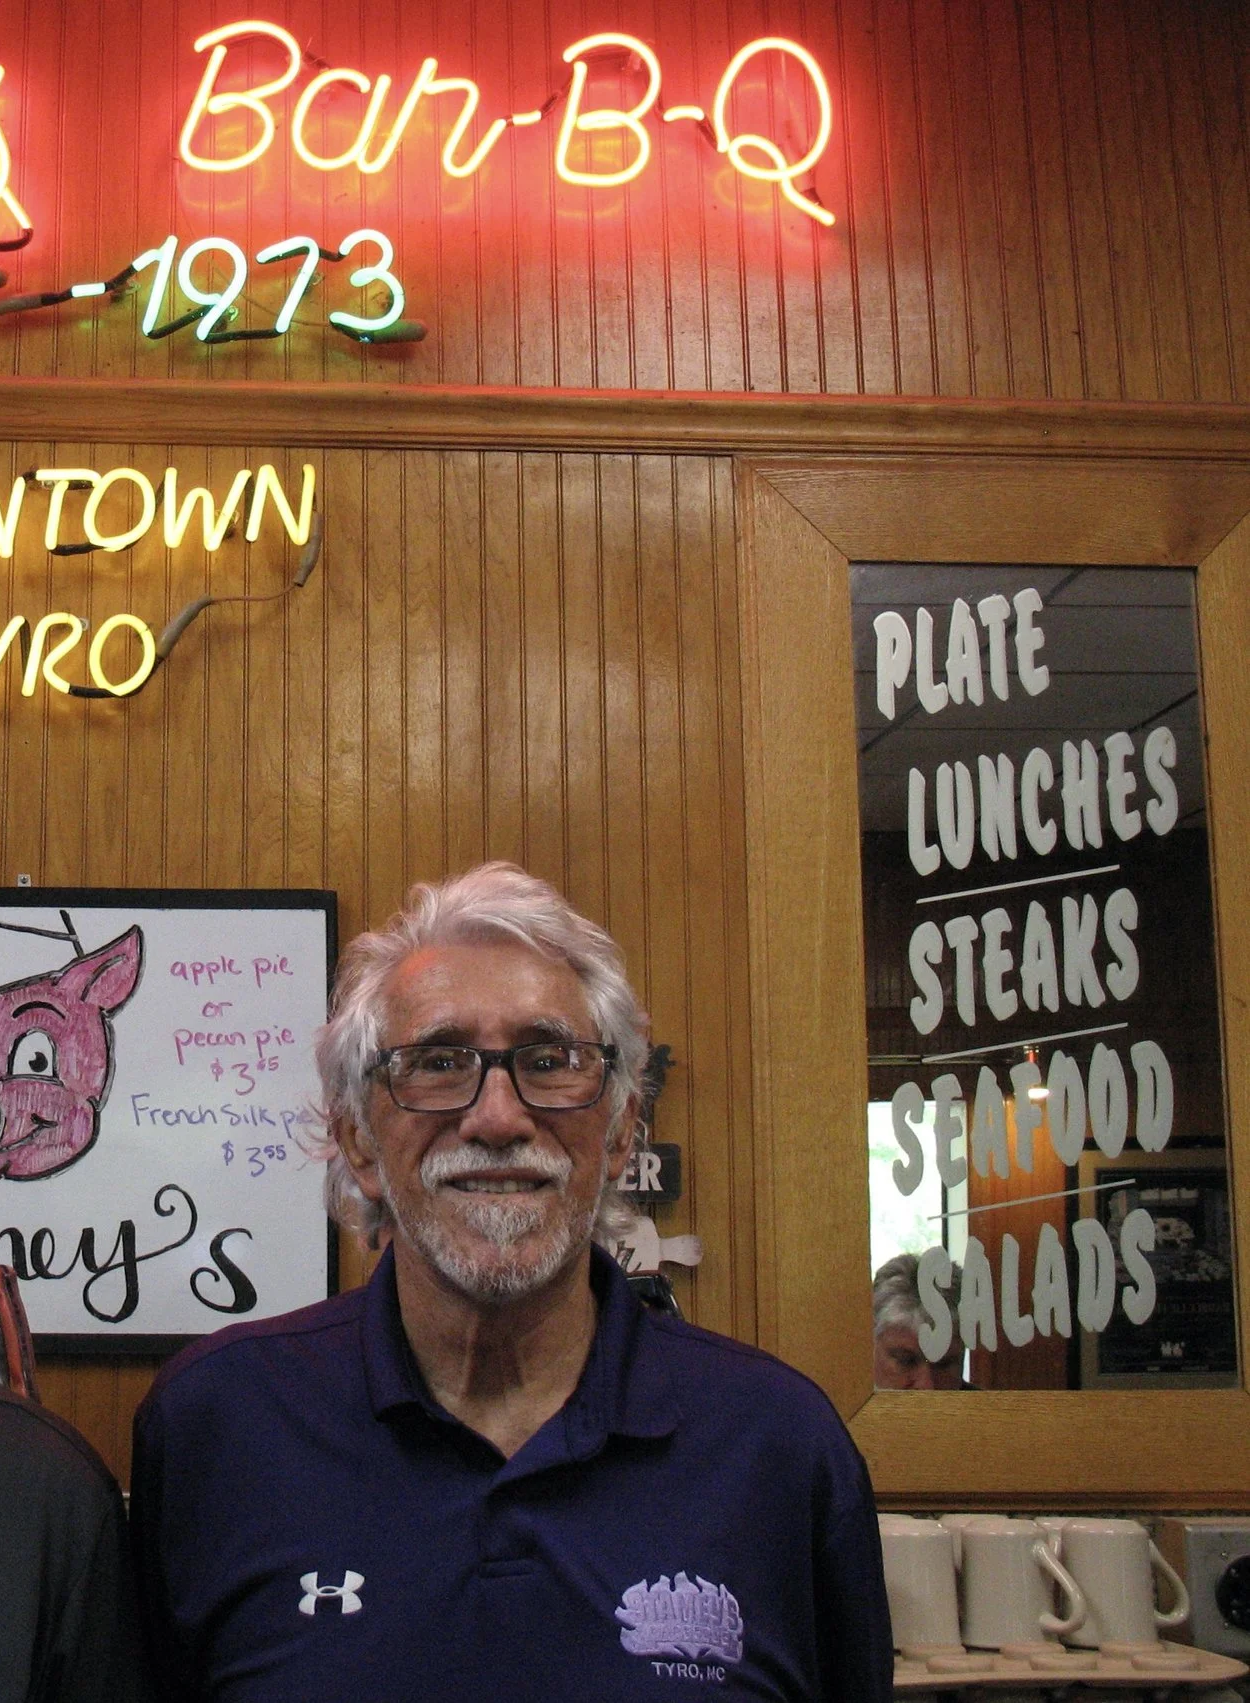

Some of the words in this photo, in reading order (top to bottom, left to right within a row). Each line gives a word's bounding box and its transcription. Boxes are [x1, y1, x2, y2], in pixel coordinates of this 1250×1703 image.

[179, 20, 837, 226] Bar-B-Q
[873, 587, 1050, 721] PLATE
[907, 726, 1179, 876] LUNCHES
[169, 955, 243, 986] apple
[253, 953, 295, 989] pie
[202, 1001, 233, 1018] or
[908, 888, 1141, 1036] STEAKS
[131, 1092, 218, 1127] French
[220, 1103, 277, 1127] Silk
[173, 1028, 246, 1066] pecan
[255, 1024, 296, 1058] pie
[891, 1040, 1174, 1197] SEAFOOD
[916, 1208, 1157, 1363] SALADS
